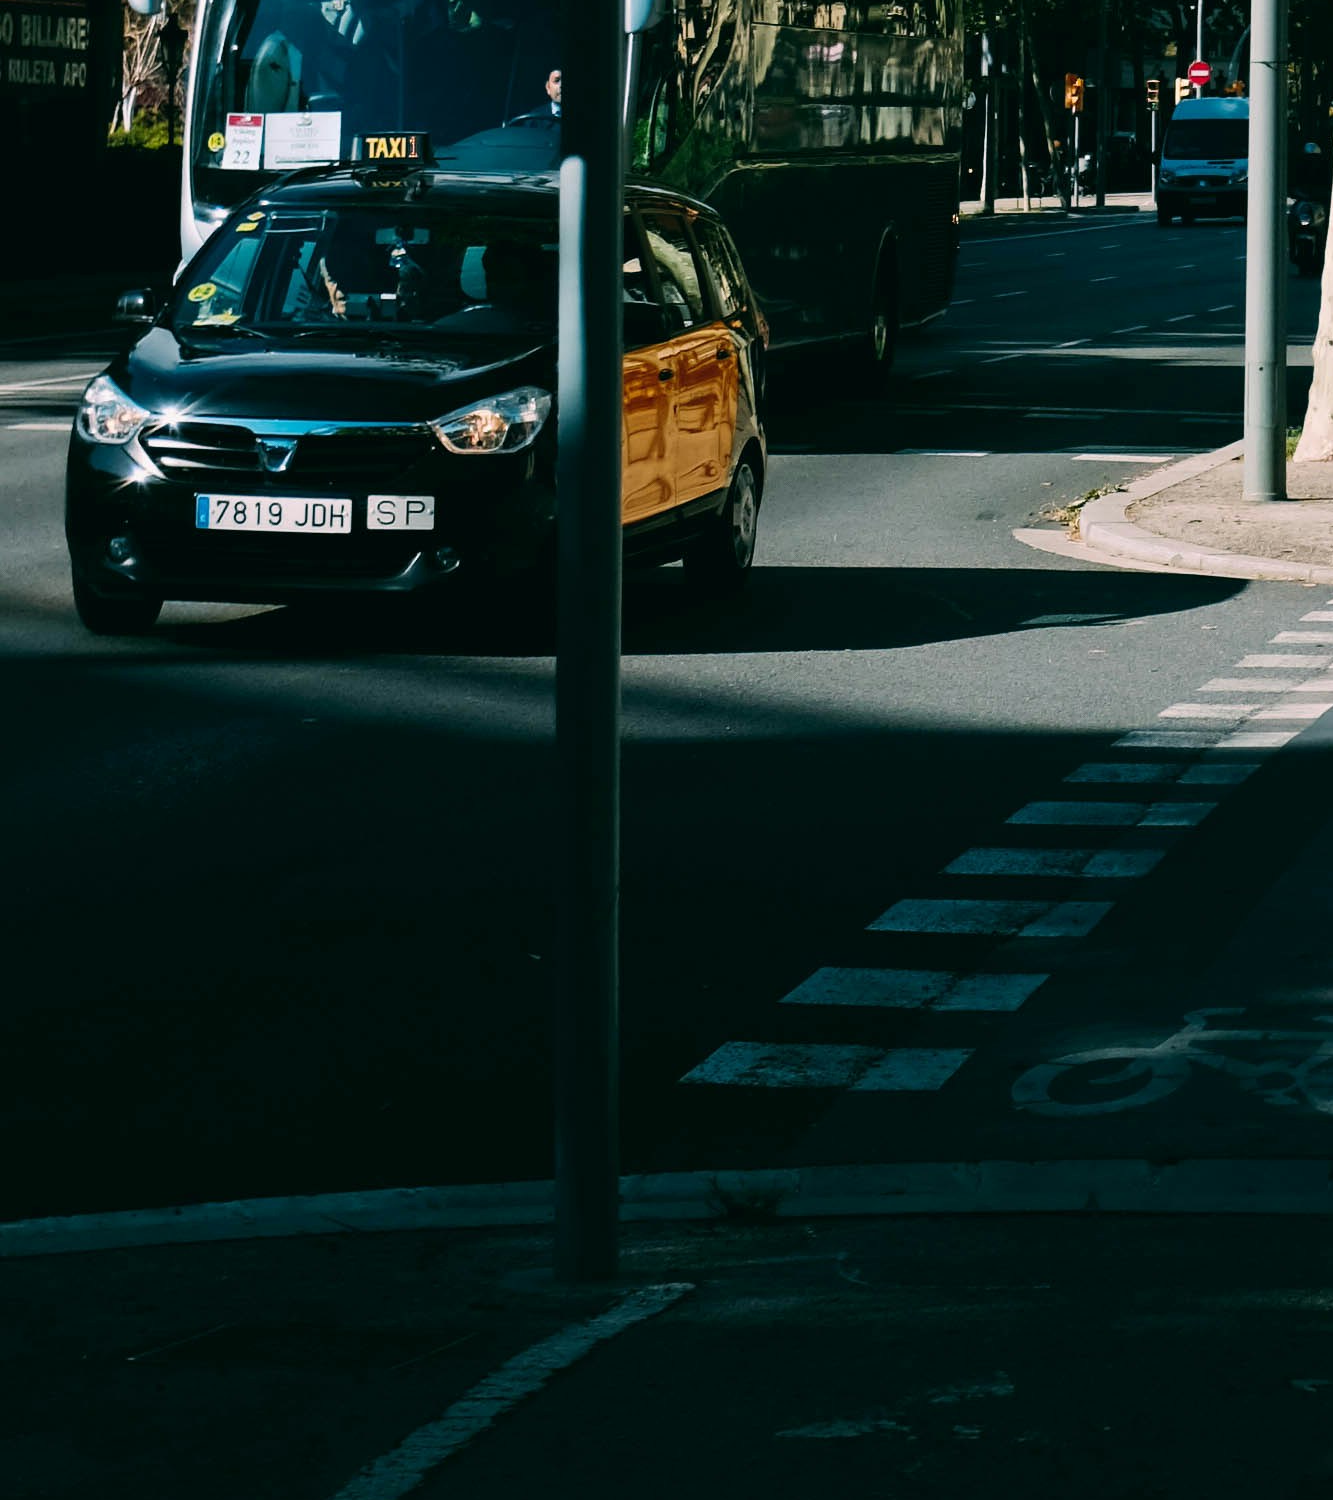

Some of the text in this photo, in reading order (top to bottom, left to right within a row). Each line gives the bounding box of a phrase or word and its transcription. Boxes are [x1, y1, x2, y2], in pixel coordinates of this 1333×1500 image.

[8, 58, 56, 85] RULETA
[232, 150, 250, 164] 22
[365, 135, 418, 159] TAXI 1
[215, 500, 345, 528] 7819 JDH
